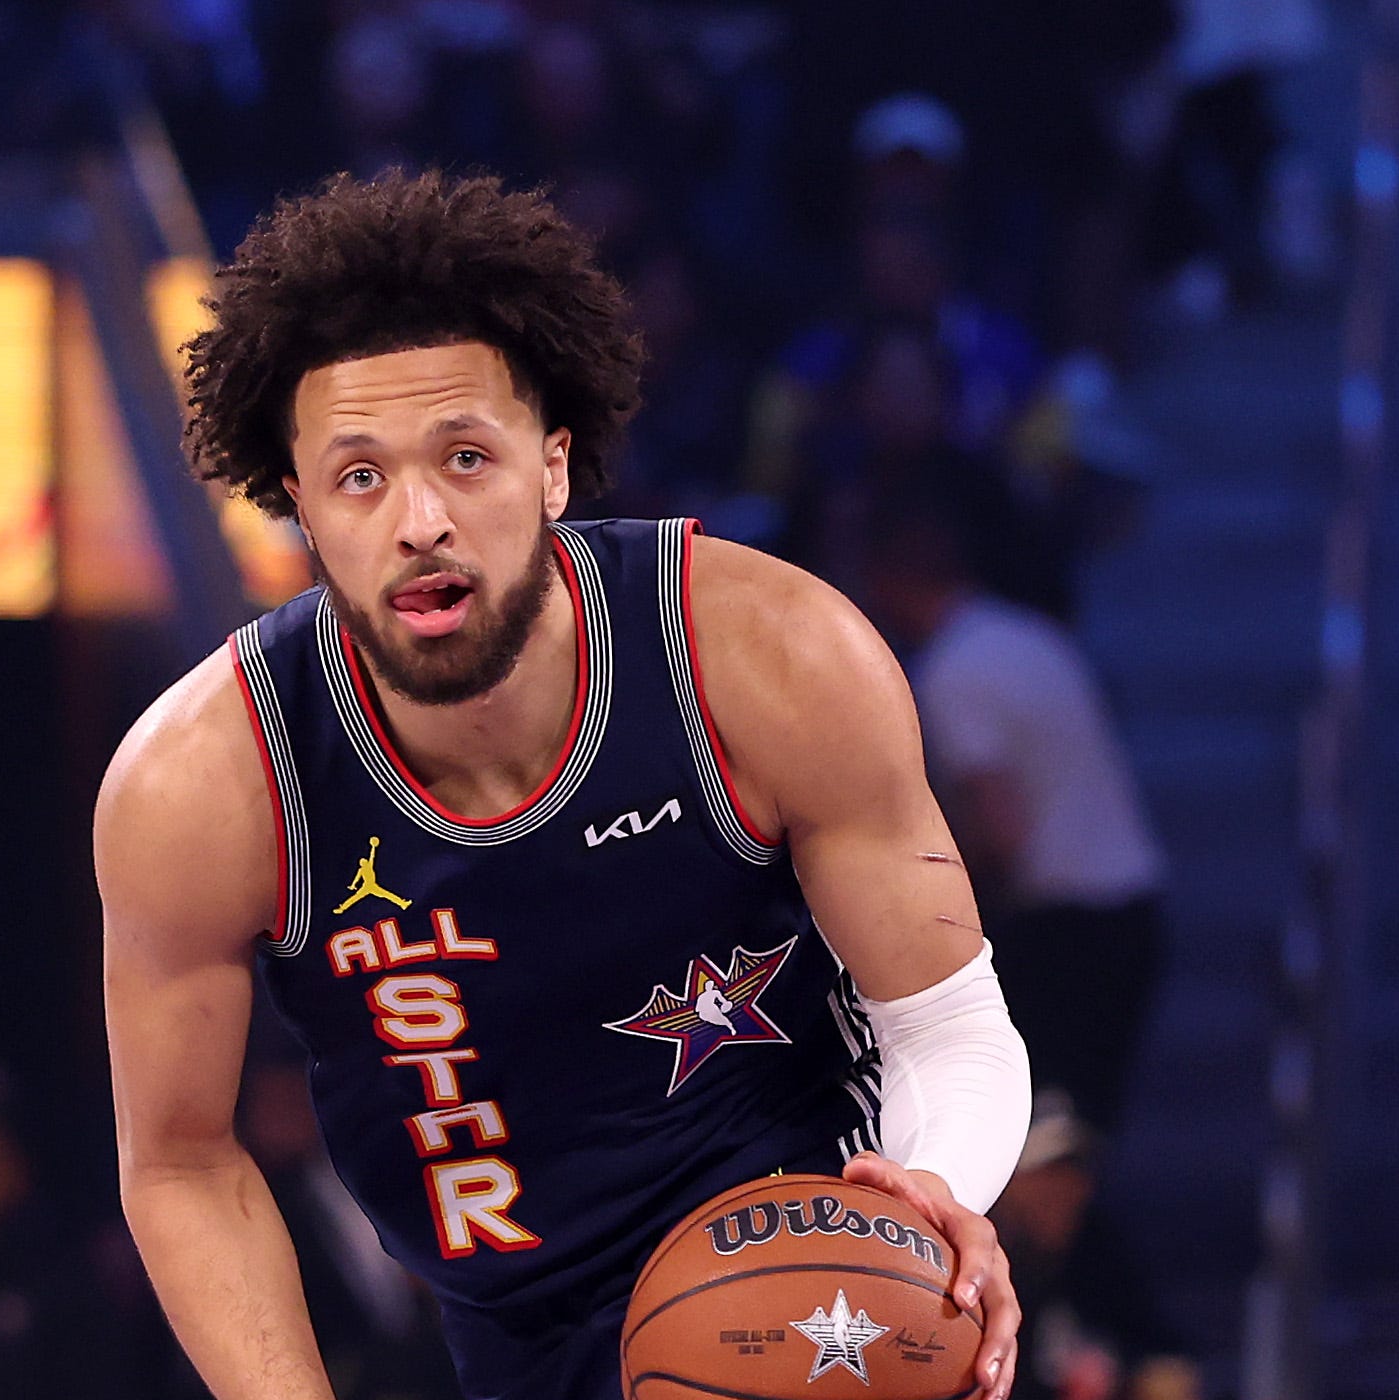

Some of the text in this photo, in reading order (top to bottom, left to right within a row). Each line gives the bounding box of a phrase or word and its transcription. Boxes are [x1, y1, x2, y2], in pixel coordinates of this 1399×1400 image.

[324, 908, 499, 978] ALL
[364, 973, 543, 1260] STAR
[705, 1196, 949, 1275] Wilson
